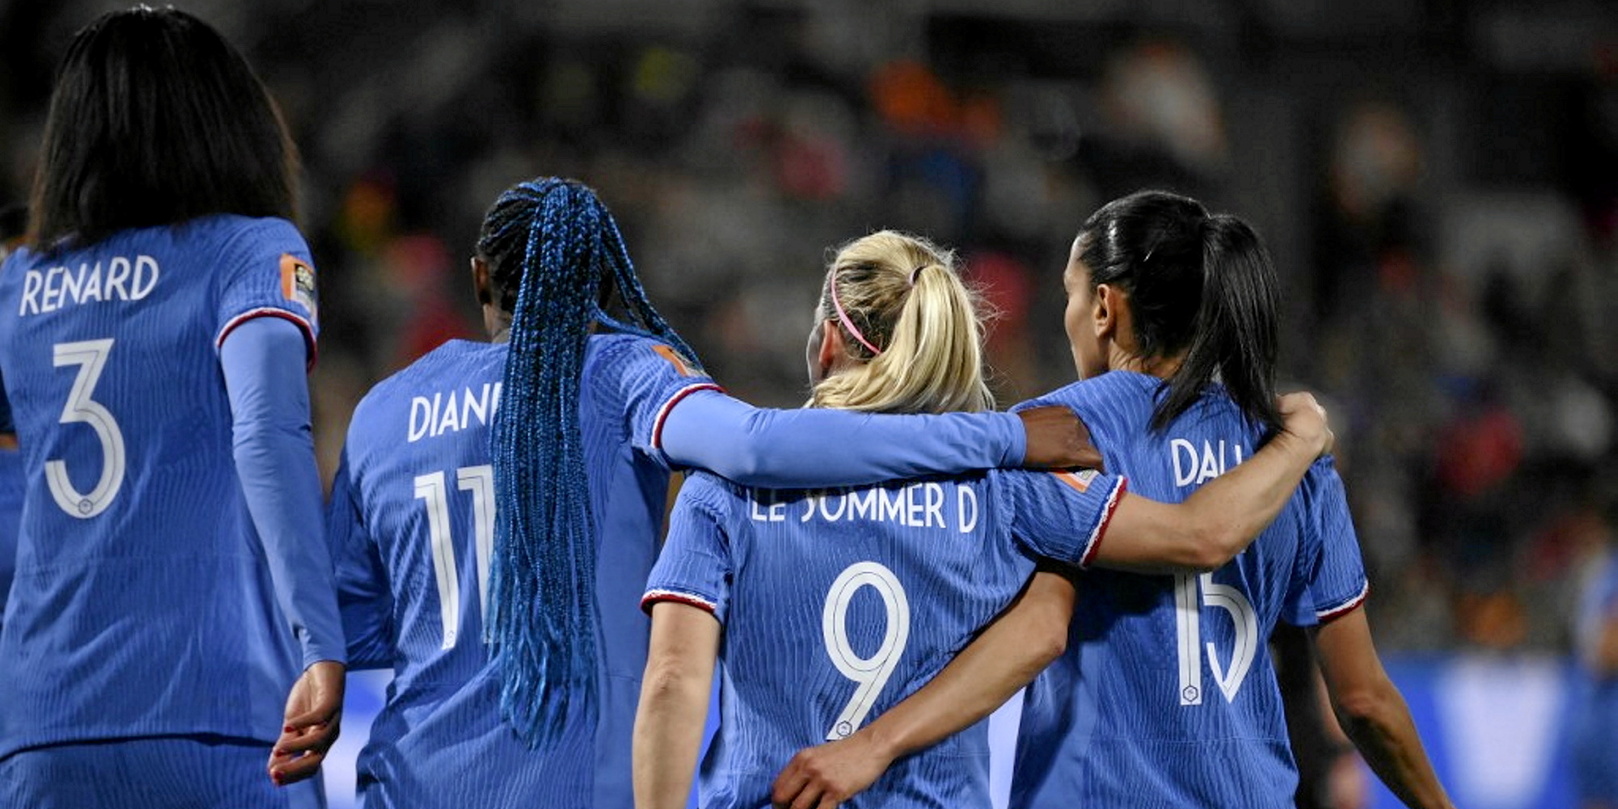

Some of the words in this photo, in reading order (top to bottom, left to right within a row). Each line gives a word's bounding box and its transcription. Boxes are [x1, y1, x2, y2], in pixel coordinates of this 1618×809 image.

[19, 255, 159, 317] RENARD
[44, 338, 126, 519] 3
[414, 465, 496, 650] 11
[958, 484, 978, 533] D
[822, 561, 910, 740] 9
[1174, 571, 1258, 706] 15
